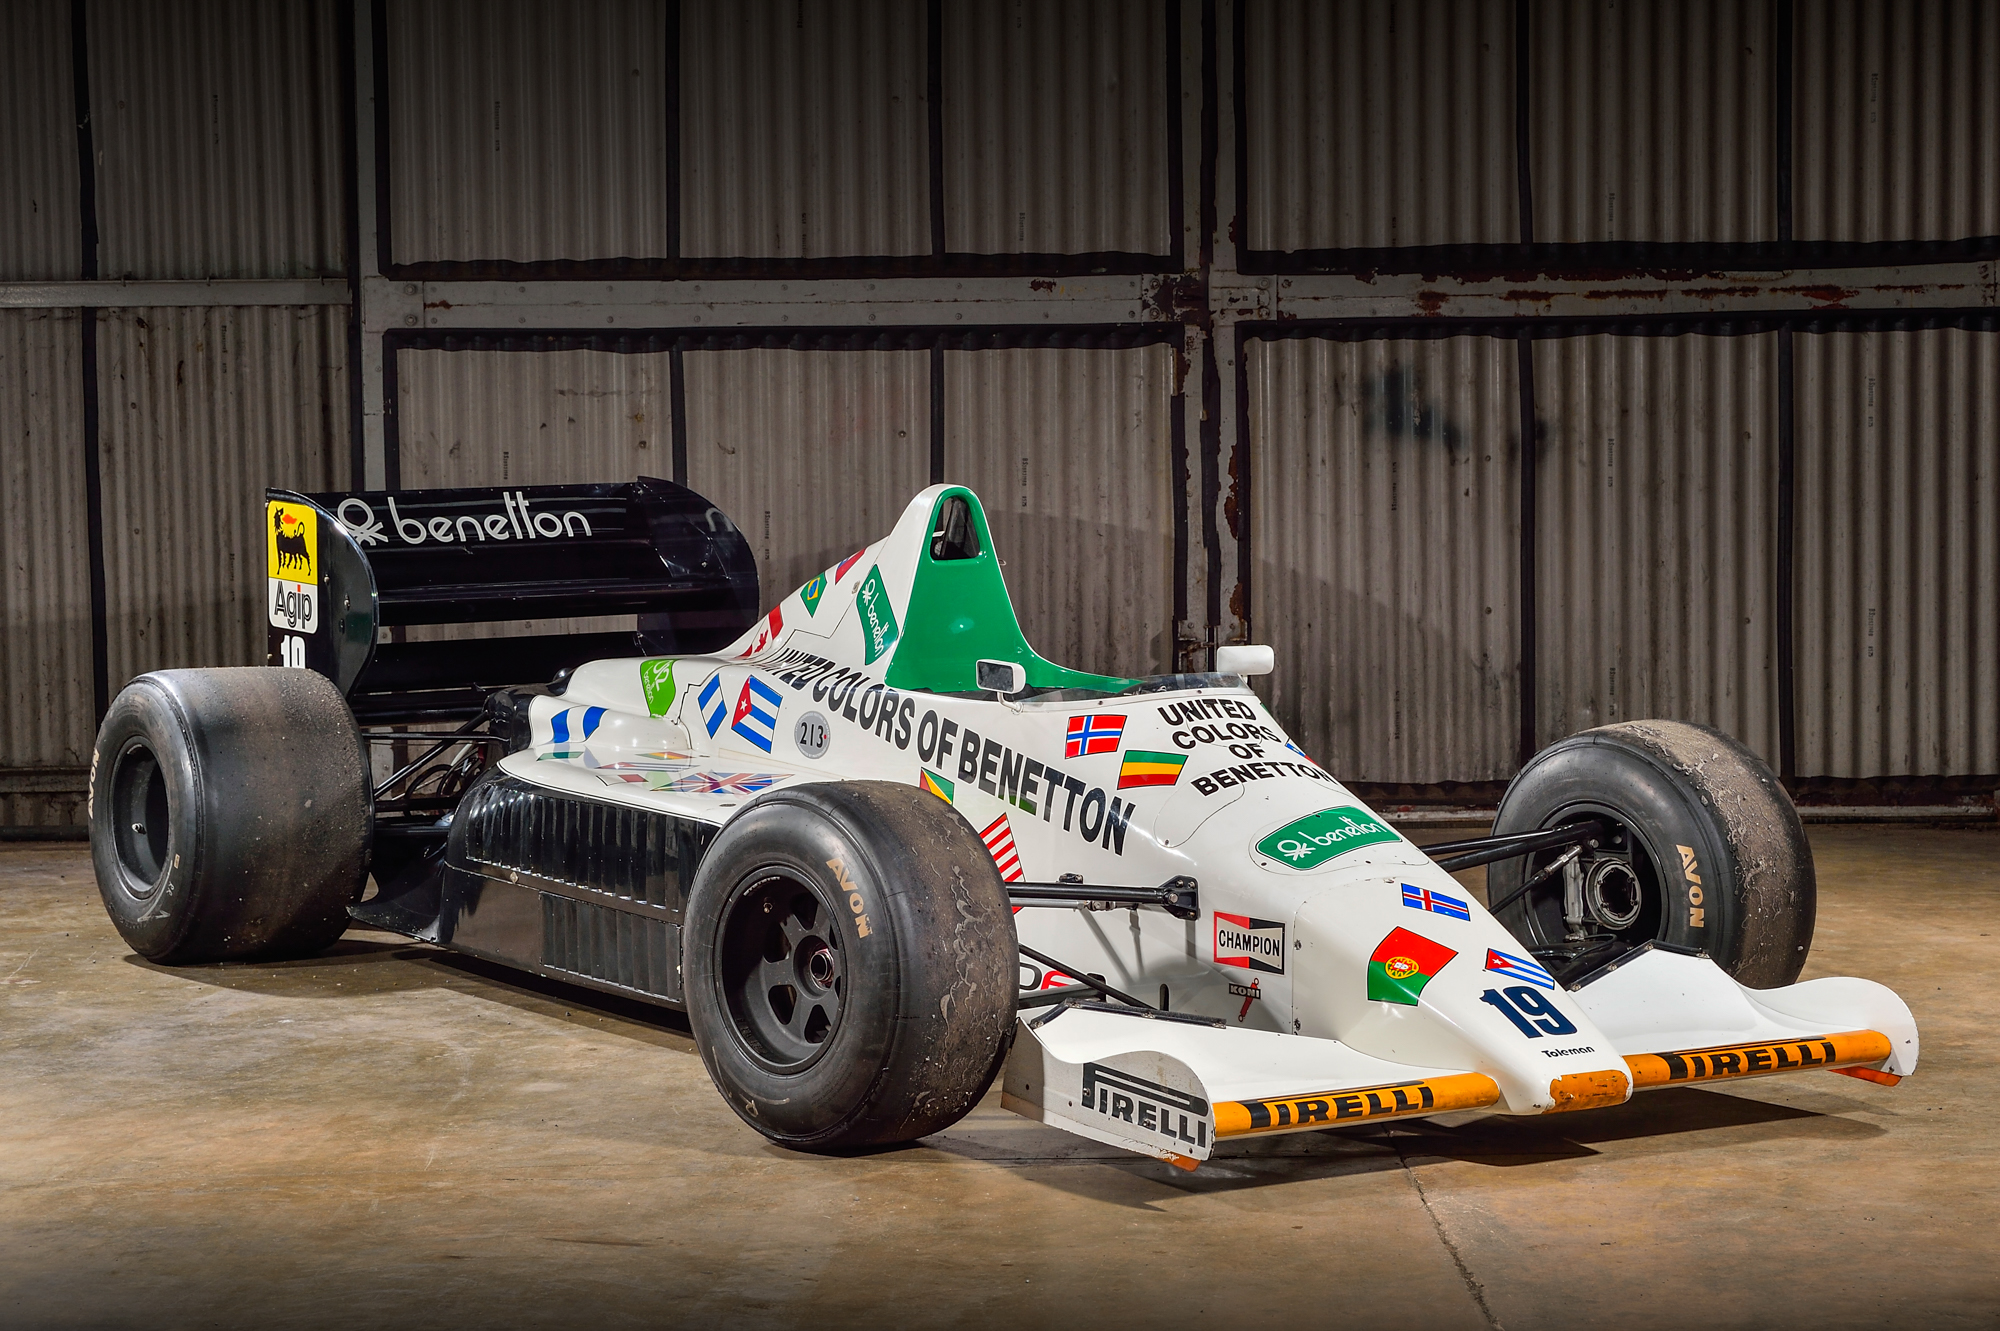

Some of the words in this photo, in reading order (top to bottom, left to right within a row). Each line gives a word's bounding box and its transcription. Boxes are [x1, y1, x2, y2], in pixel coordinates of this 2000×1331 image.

[387, 491, 593, 545] benetton
[274, 580, 313, 629] Agip
[867, 592, 890, 658] benetton
[799, 721, 825, 749] 213
[1157, 698, 1257, 726] UNITED
[1171, 721, 1282, 750] COLORS
[1227, 743, 1266, 760] OF
[812, 666, 916, 751] COLORS
[916, 709, 960, 770] OF
[957, 728, 1137, 857] BENETTON
[1190, 761, 1339, 797] BENETTON
[1297, 815, 1388, 846] benetton
[825, 857, 874, 939] AVON
[1675, 844, 1705, 928] AVON
[1218, 929, 1280, 957] CHAMPION
[1229, 984, 1260, 998] KONI
[1479, 985, 1578, 1039] 19
[1541, 1046, 1595, 1058] Toleman
[1650, 1034, 1837, 1080] PIRELLI
[1081, 1061, 1208, 1148] PIRELLI
[1235, 1079, 1435, 1130] PIRELLI
